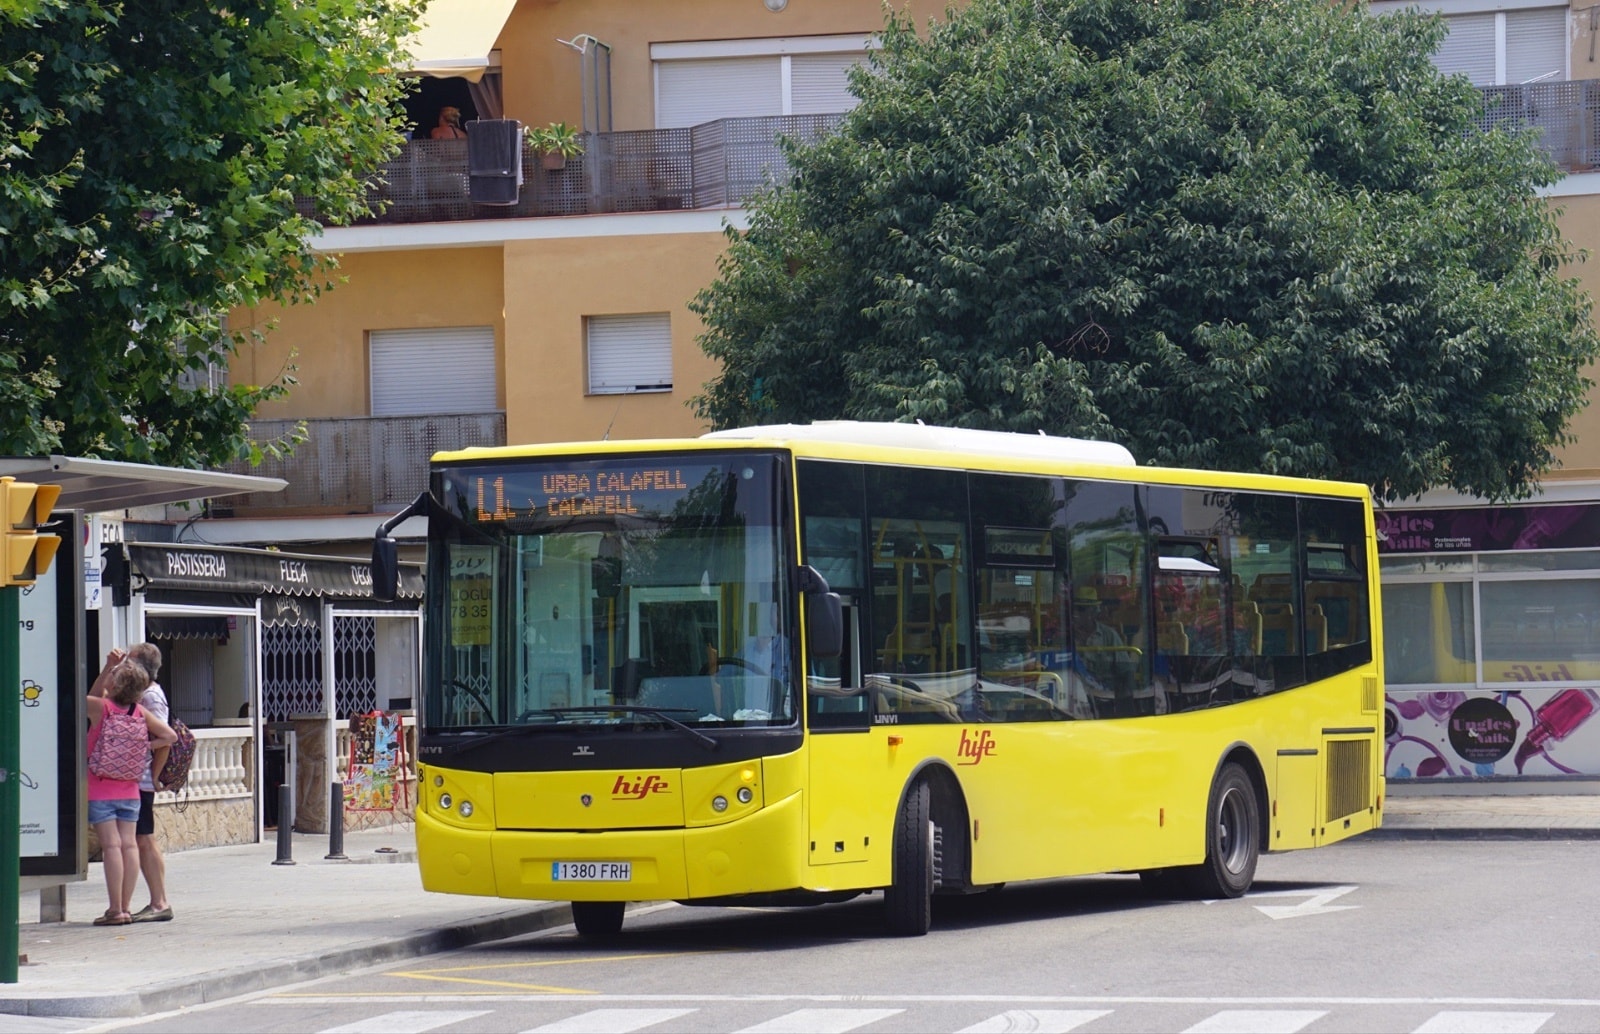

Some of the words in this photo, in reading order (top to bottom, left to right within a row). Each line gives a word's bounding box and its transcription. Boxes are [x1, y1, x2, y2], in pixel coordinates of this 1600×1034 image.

[542, 474, 591, 494] URBA
[597, 470, 687, 491] CALAFELL
[547, 494, 638, 516] CALAFELL
[167, 552, 227, 578] PASTISSERIA
[279, 559, 309, 583] FLECA
[472, 604, 488, 618] 35
[874, 714, 898, 723] UNVI
[957, 728, 998, 766] hife
[611, 775, 673, 801] hife
[562, 864, 596, 879] 1380
[600, 864, 629, 879] FRH
